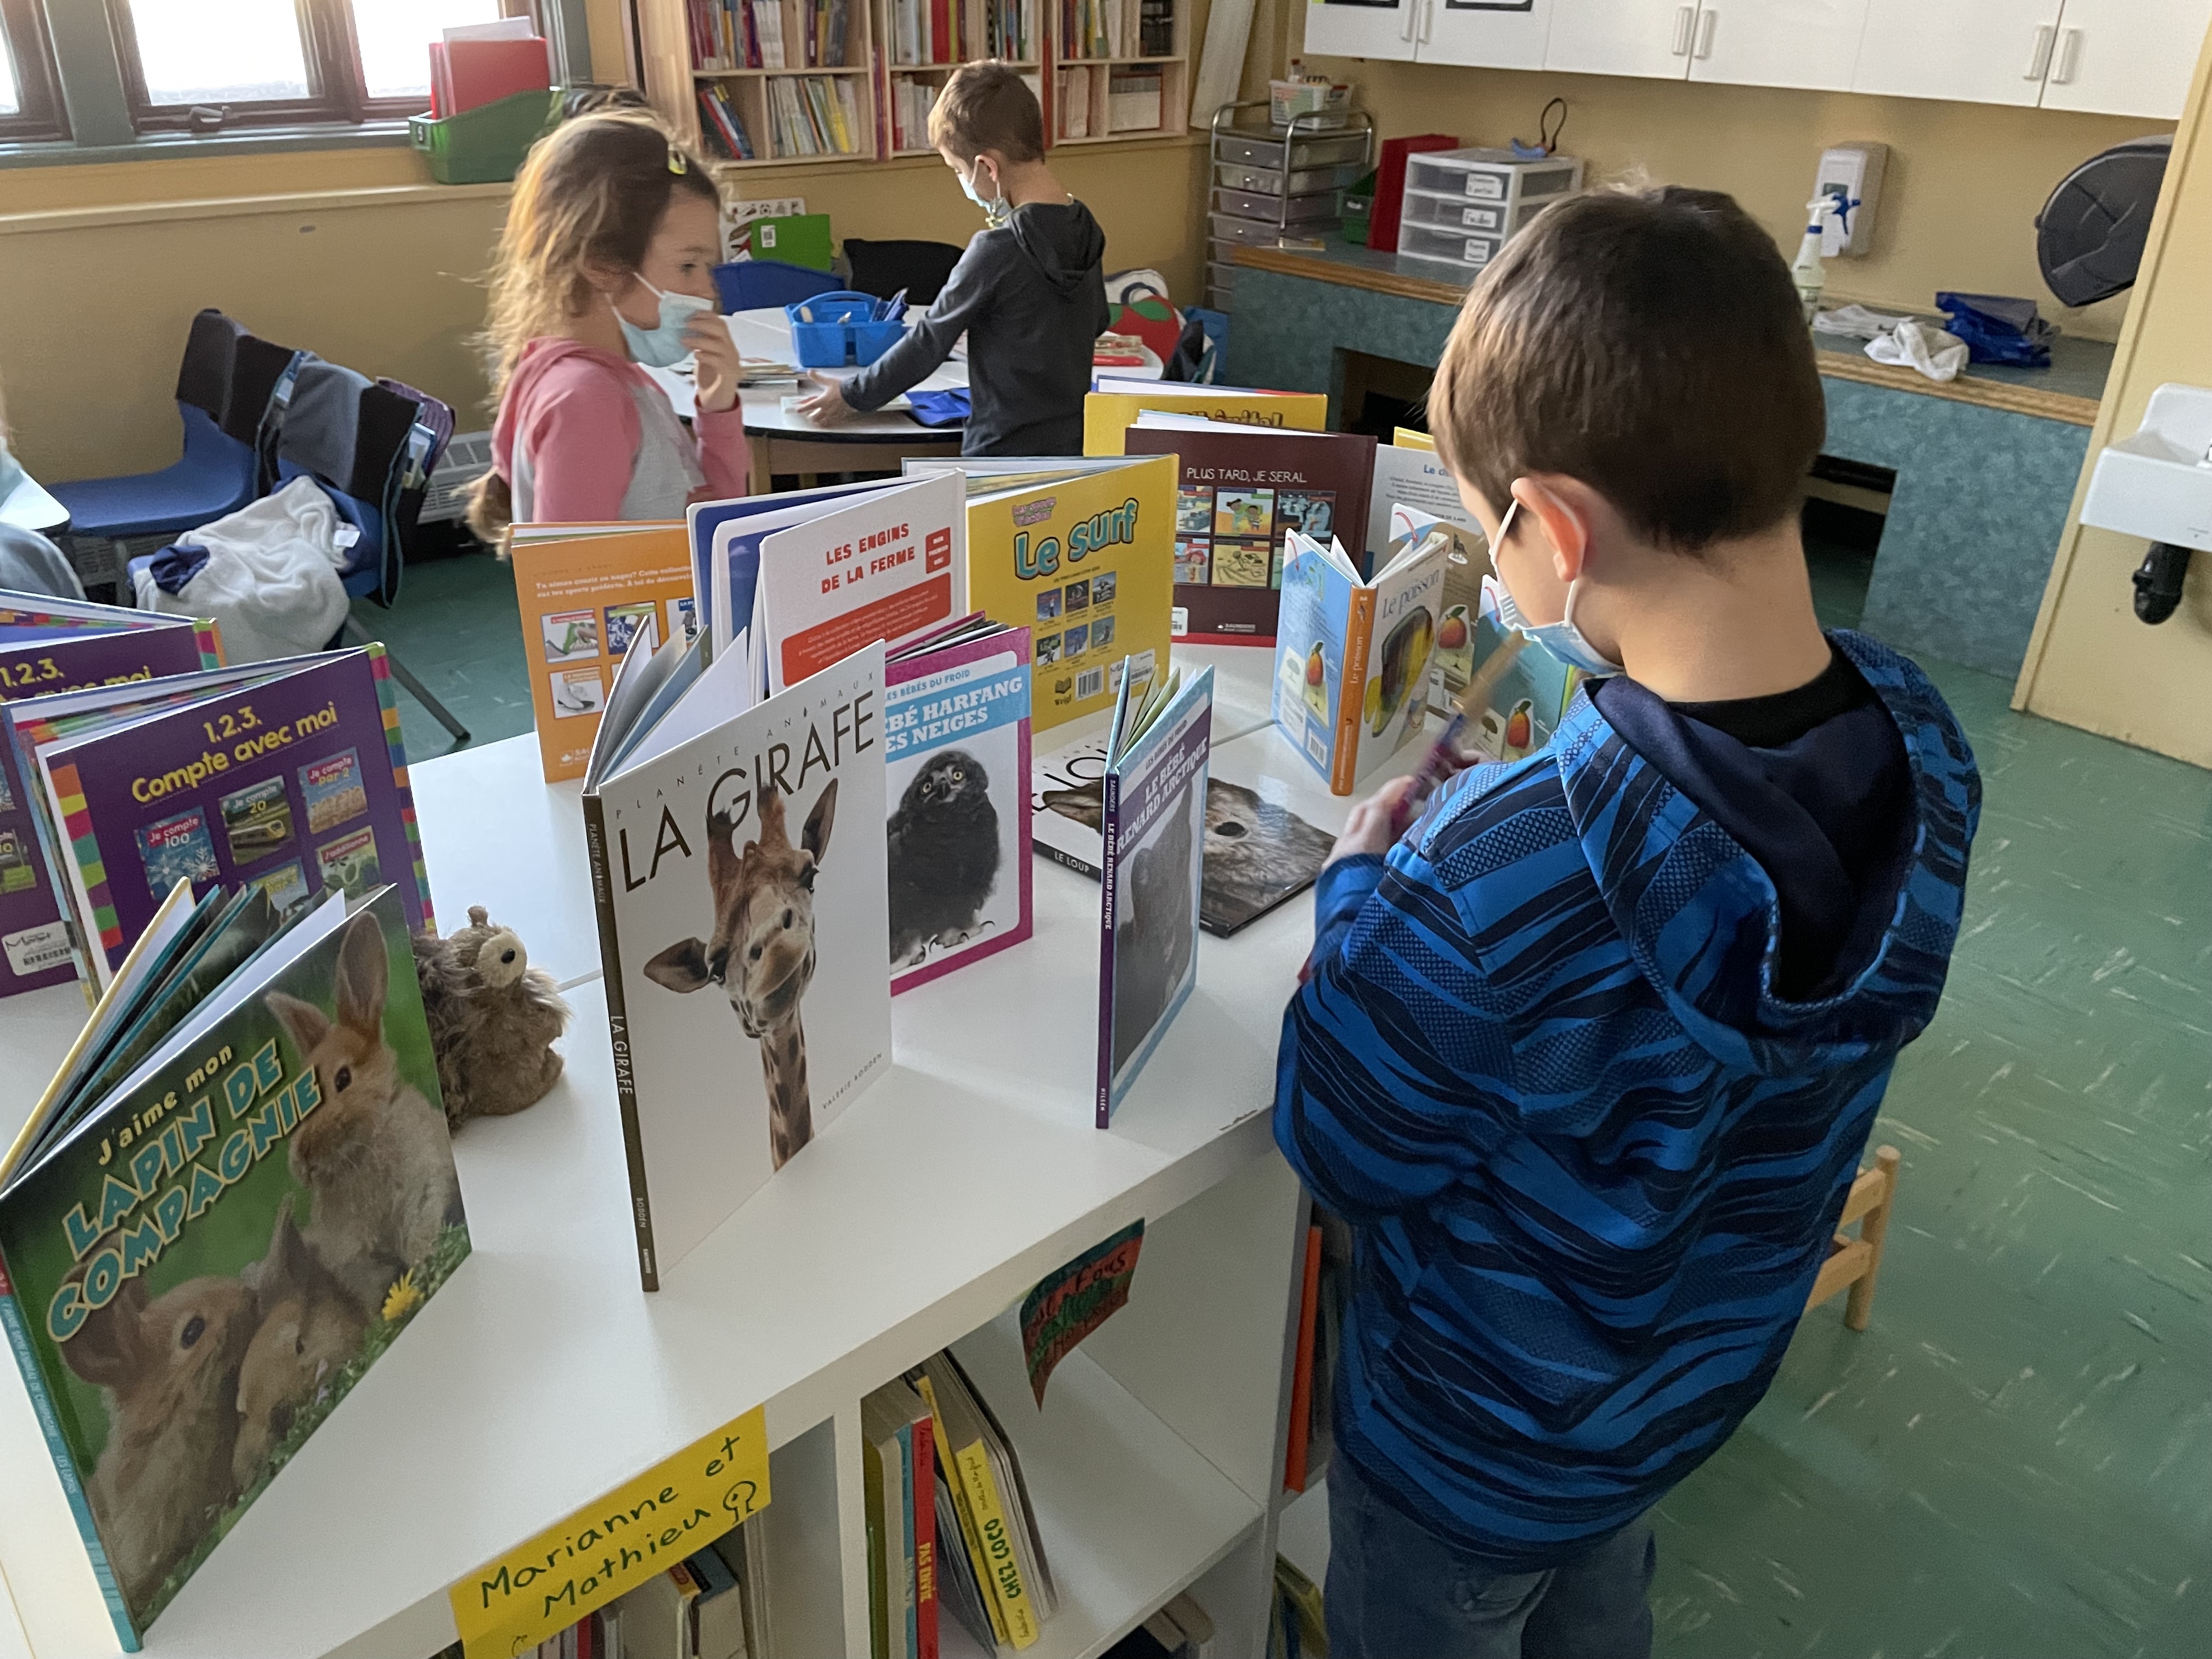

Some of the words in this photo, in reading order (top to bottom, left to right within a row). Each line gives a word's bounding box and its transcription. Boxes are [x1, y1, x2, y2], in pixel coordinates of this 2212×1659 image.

[1187, 467, 1215, 480] PLUS
[1253, 470, 1266, 482] JE
[826, 544, 851, 565] LES
[859, 523, 909, 553] ENGINS
[1014, 531, 1060, 580] Le
[1068, 497, 1139, 562] surf
[821, 574, 839, 594] DE
[847, 566, 864, 584] LA
[871, 546, 915, 575] FERME
[885, 690, 897, 701] ES
[930, 677, 942, 688] DU
[945, 670, 970, 684] FROID
[885, 704, 918, 734] BÉ
[922, 676, 1023, 723] HARFANG
[132, 752, 229, 803] Compte
[234, 726, 292, 761] avec
[296, 701, 338, 736] moi
[885, 731, 908, 754] ES
[912, 707, 988, 745] NEIGES
[619, 804, 692, 893] LA
[707, 690, 873, 832] GIRAFE
[1116, 794, 1160, 855] RENARD
[1162, 737, 1207, 802] ARCTIQUE
[1146, 775, 1159, 803] LE
[1160, 742, 1185, 787] BÉBÉ
[250, 800, 267, 814] 20
[165, 833, 189, 849] 100
[1054, 851, 1064, 862] LE
[1066, 856, 1090, 873] LOUP
[610, 1016, 625, 1034] LA
[185, 1045, 232, 1092] mon
[613, 1041, 633, 1094] GIRAFE
[62, 1095, 217, 1261] LAPIN
[223, 1037, 283, 1120] DE
[46, 1064, 322, 1342] COMPAGNIE
[481, 1486, 678, 1609] Marianne
[706, 1436, 740, 1477] et
[984, 1518, 1011, 1560] COCO
[543, 1506, 711, 1619] Mathieu
[998, 1561, 1022, 1599] CHEZ
